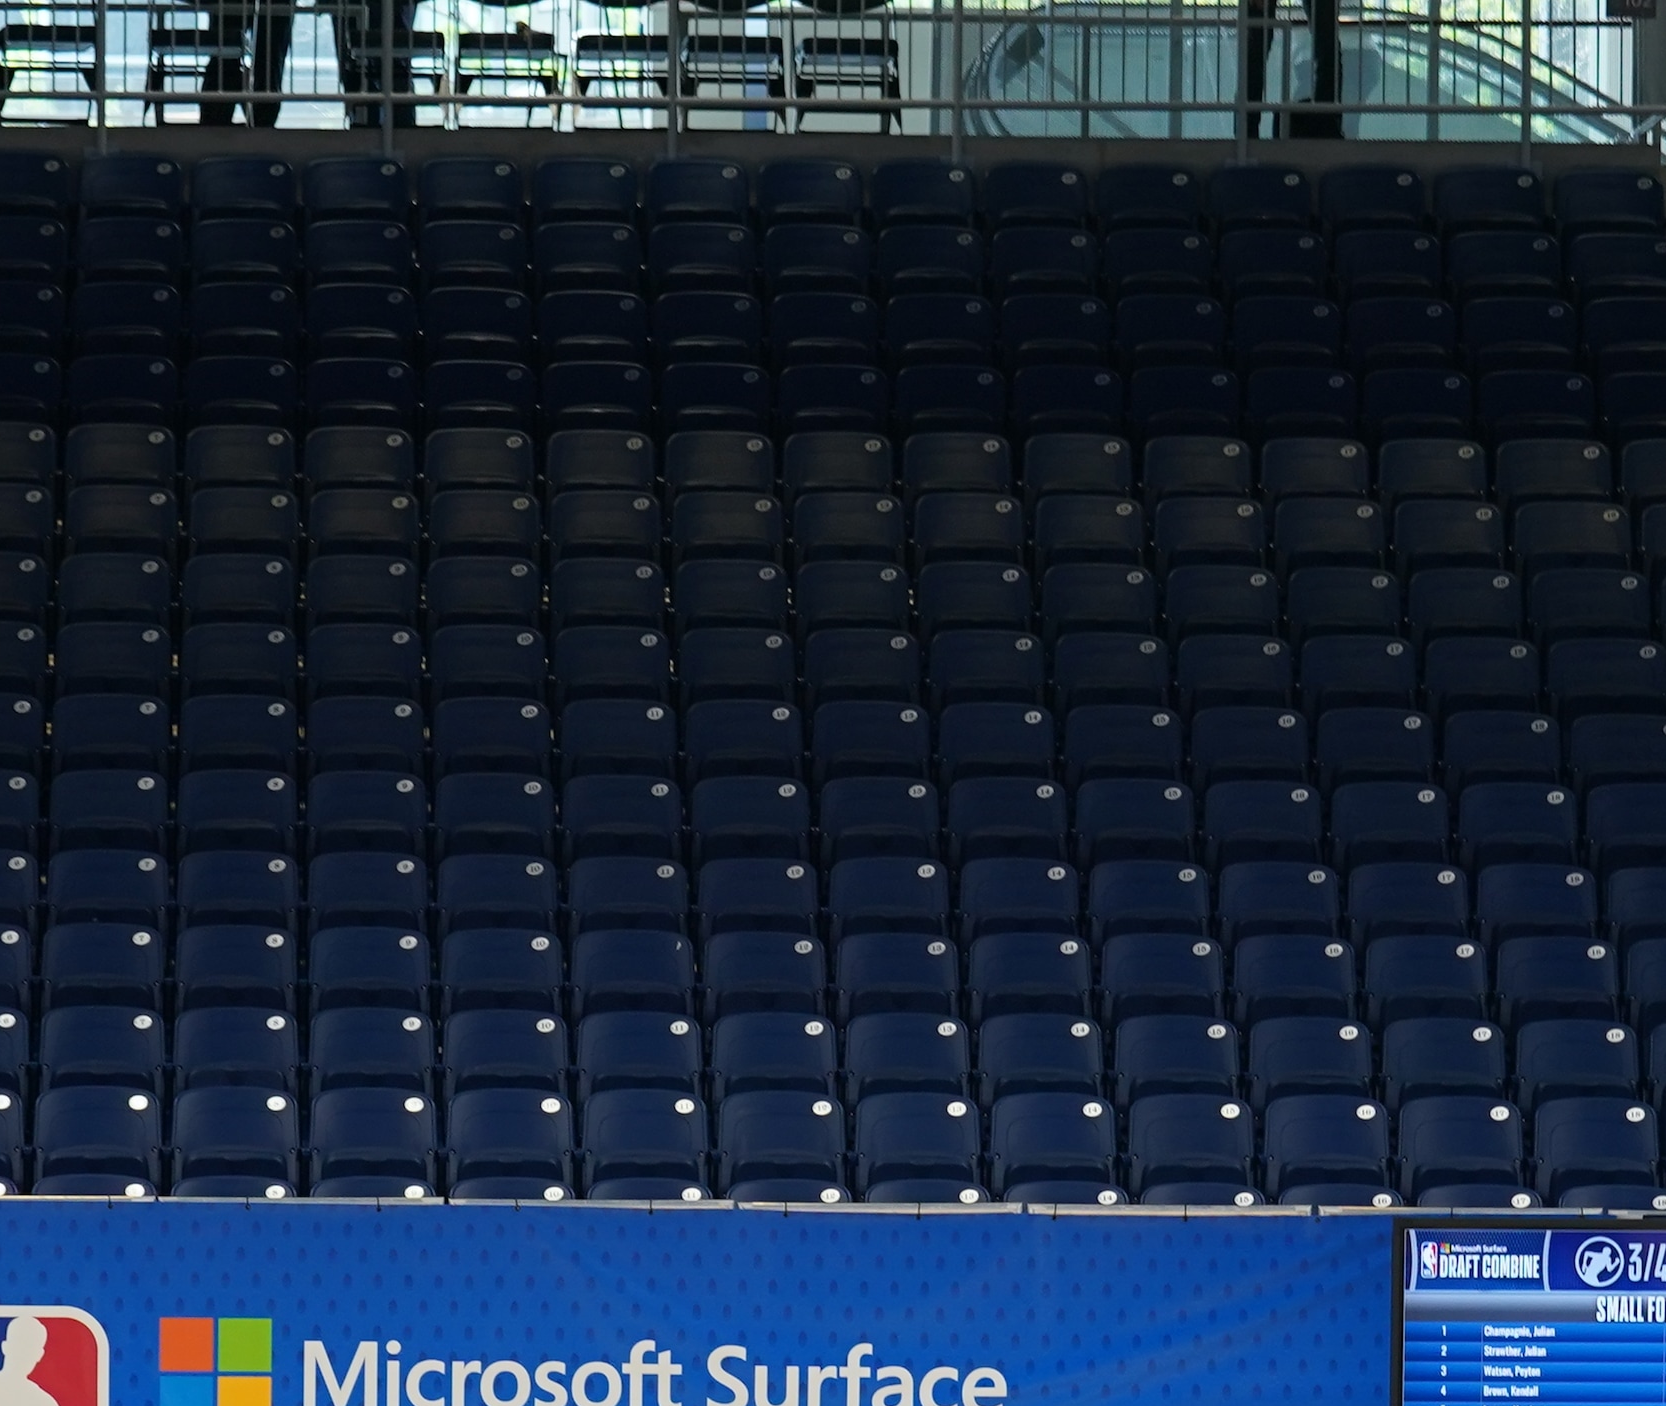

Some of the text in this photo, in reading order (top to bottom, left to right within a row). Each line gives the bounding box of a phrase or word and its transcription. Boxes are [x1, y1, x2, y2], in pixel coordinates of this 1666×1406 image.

[1440, 1254, 1540, 1279] DRAFT COMBINE
[1596, 1295, 1644, 1322] SMALL
[1442, 1325, 1447, 1337] 1
[1441, 1345, 1448, 1357] 2
[1440, 1365, 1447, 1377] 3
[1440, 1385, 1447, 1396] 4
